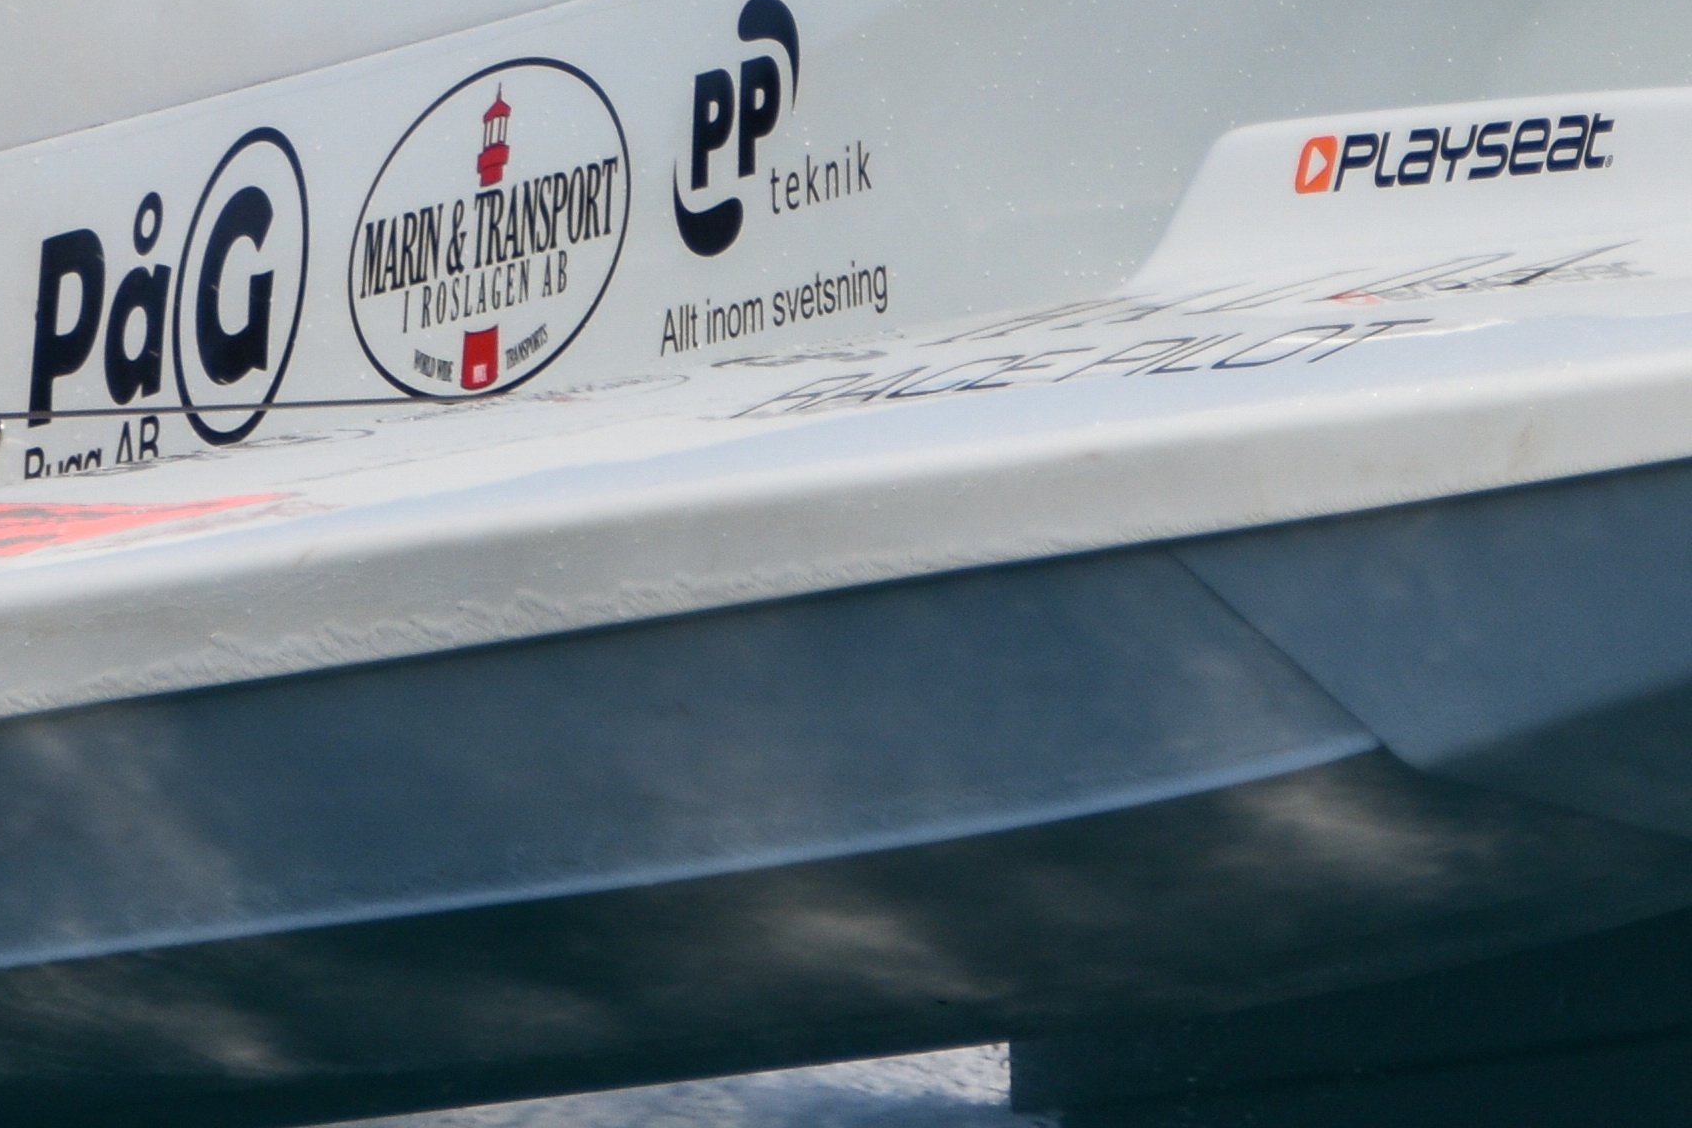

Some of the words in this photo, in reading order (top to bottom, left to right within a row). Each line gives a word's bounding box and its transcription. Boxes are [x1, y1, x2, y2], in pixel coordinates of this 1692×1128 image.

[770, 140, 873, 215] teknik
[359, 203, 444, 300] MARIN
[446, 198, 468, 276] &
[473, 156, 619, 270] TRANSPORT
[421, 258, 531, 329] ROSLAGEN
[541, 250, 568, 298] AB
[660, 303, 699, 357] Allt
[705, 296, 765, 345] inom
[772, 260, 889, 328] svetsning
[729, 345, 1098, 420] RACE
[1053, 318, 1435, 385] PILOT
